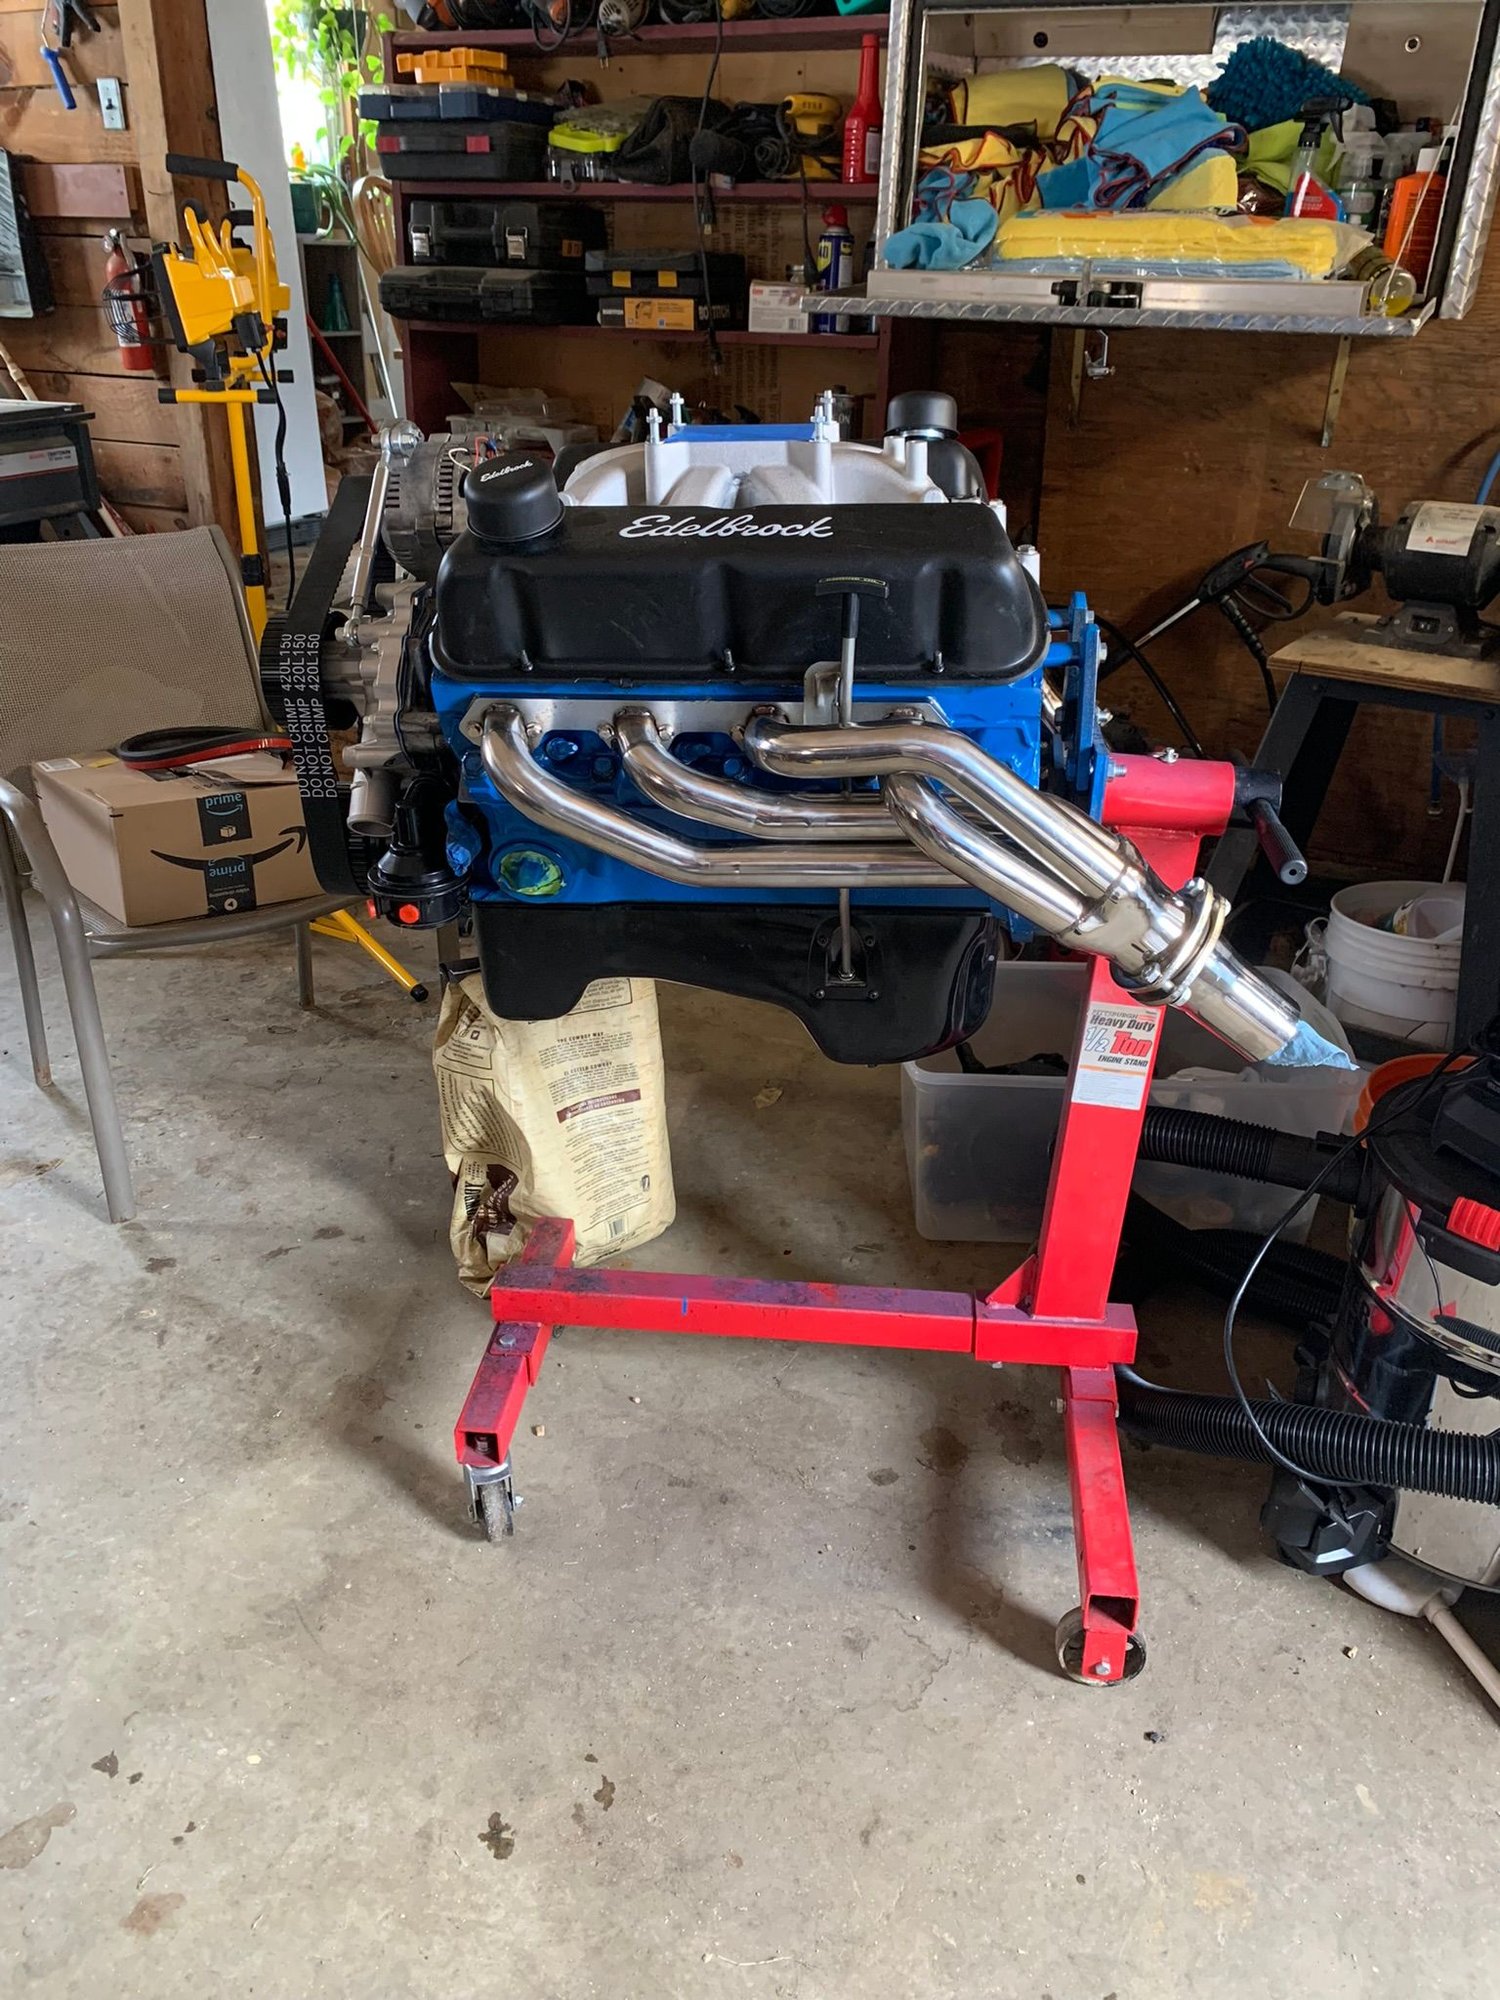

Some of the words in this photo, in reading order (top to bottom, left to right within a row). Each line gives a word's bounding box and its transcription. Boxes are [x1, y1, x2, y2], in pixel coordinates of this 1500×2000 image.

[698, 304, 731, 321] BOTITCH
[480, 460, 533, 482] Edelbrock
[618, 514, 834, 538] Edelbrock
[279, 633, 293, 691] 420L150
[292, 633, 307, 691] 420L150
[306, 633, 321, 691] 420L150
[284, 698, 300, 743] CRIMP
[296, 698, 315, 743] CRIMP
[310, 698, 329, 743] CRIMP
[304, 746, 321, 775] NOT
[318, 746, 334, 775] NOT
[298, 778, 311, 798] DO
[310, 778, 324, 798] DO
[323, 778, 338, 798] DO
[204, 793, 243, 809] prime
[209, 862, 246, 877] prime
[1089, 1014, 1127, 1028] Heavy
[1127, 1020, 1155, 1032] Duty
[1110, 1031, 1152, 1057] Ton
[1097, 1055, 1123, 1064] ENGINE
[1124, 1057, 1148, 1067] STAND
